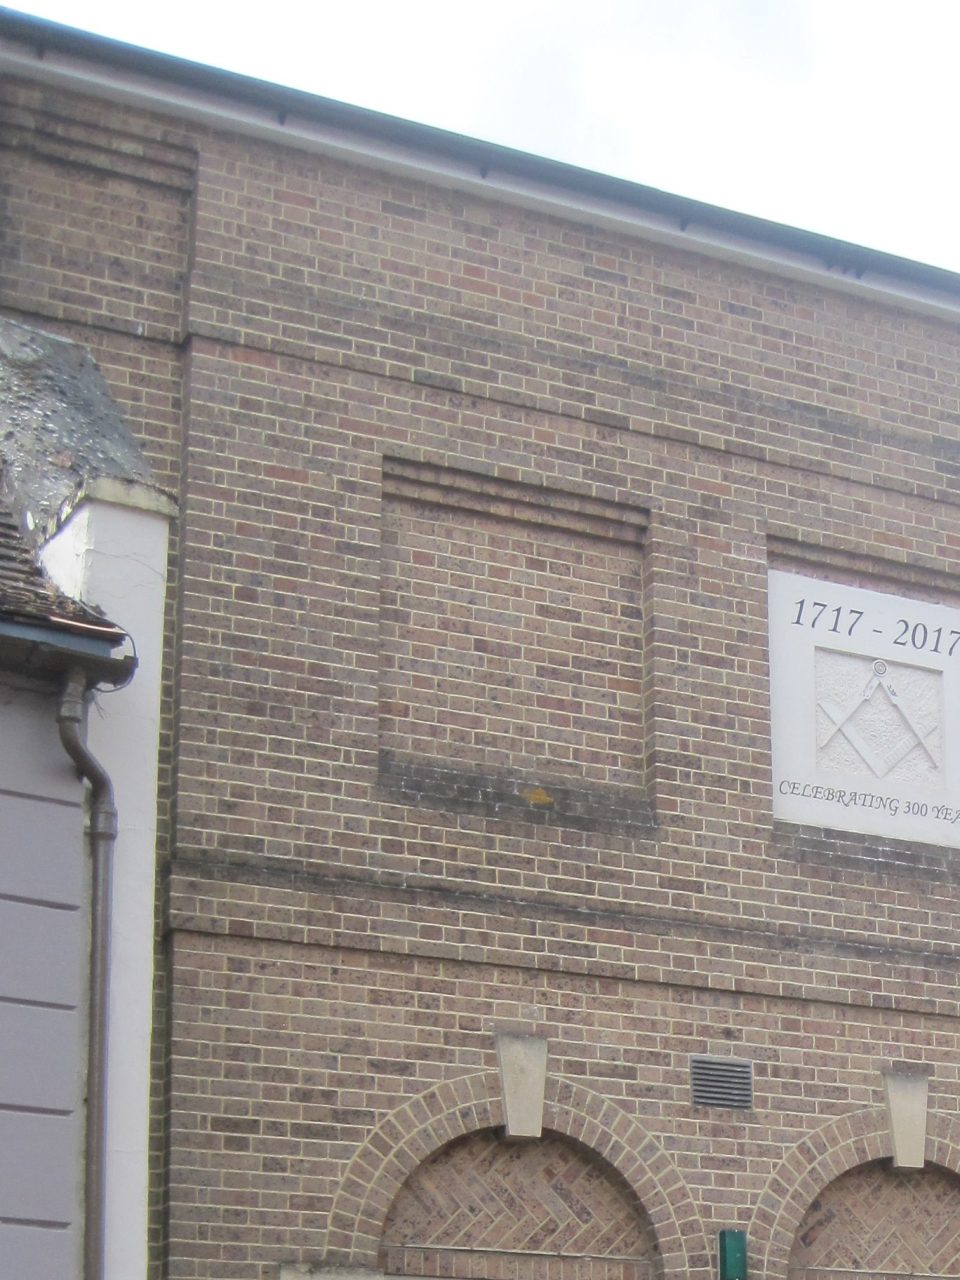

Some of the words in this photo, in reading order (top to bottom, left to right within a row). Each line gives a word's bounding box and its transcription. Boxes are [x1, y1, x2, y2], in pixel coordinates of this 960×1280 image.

[791, 598, 864, 637] 1717
[778, 779, 900, 817] CELEBRATING
[903, 801, 929, 817] 300
